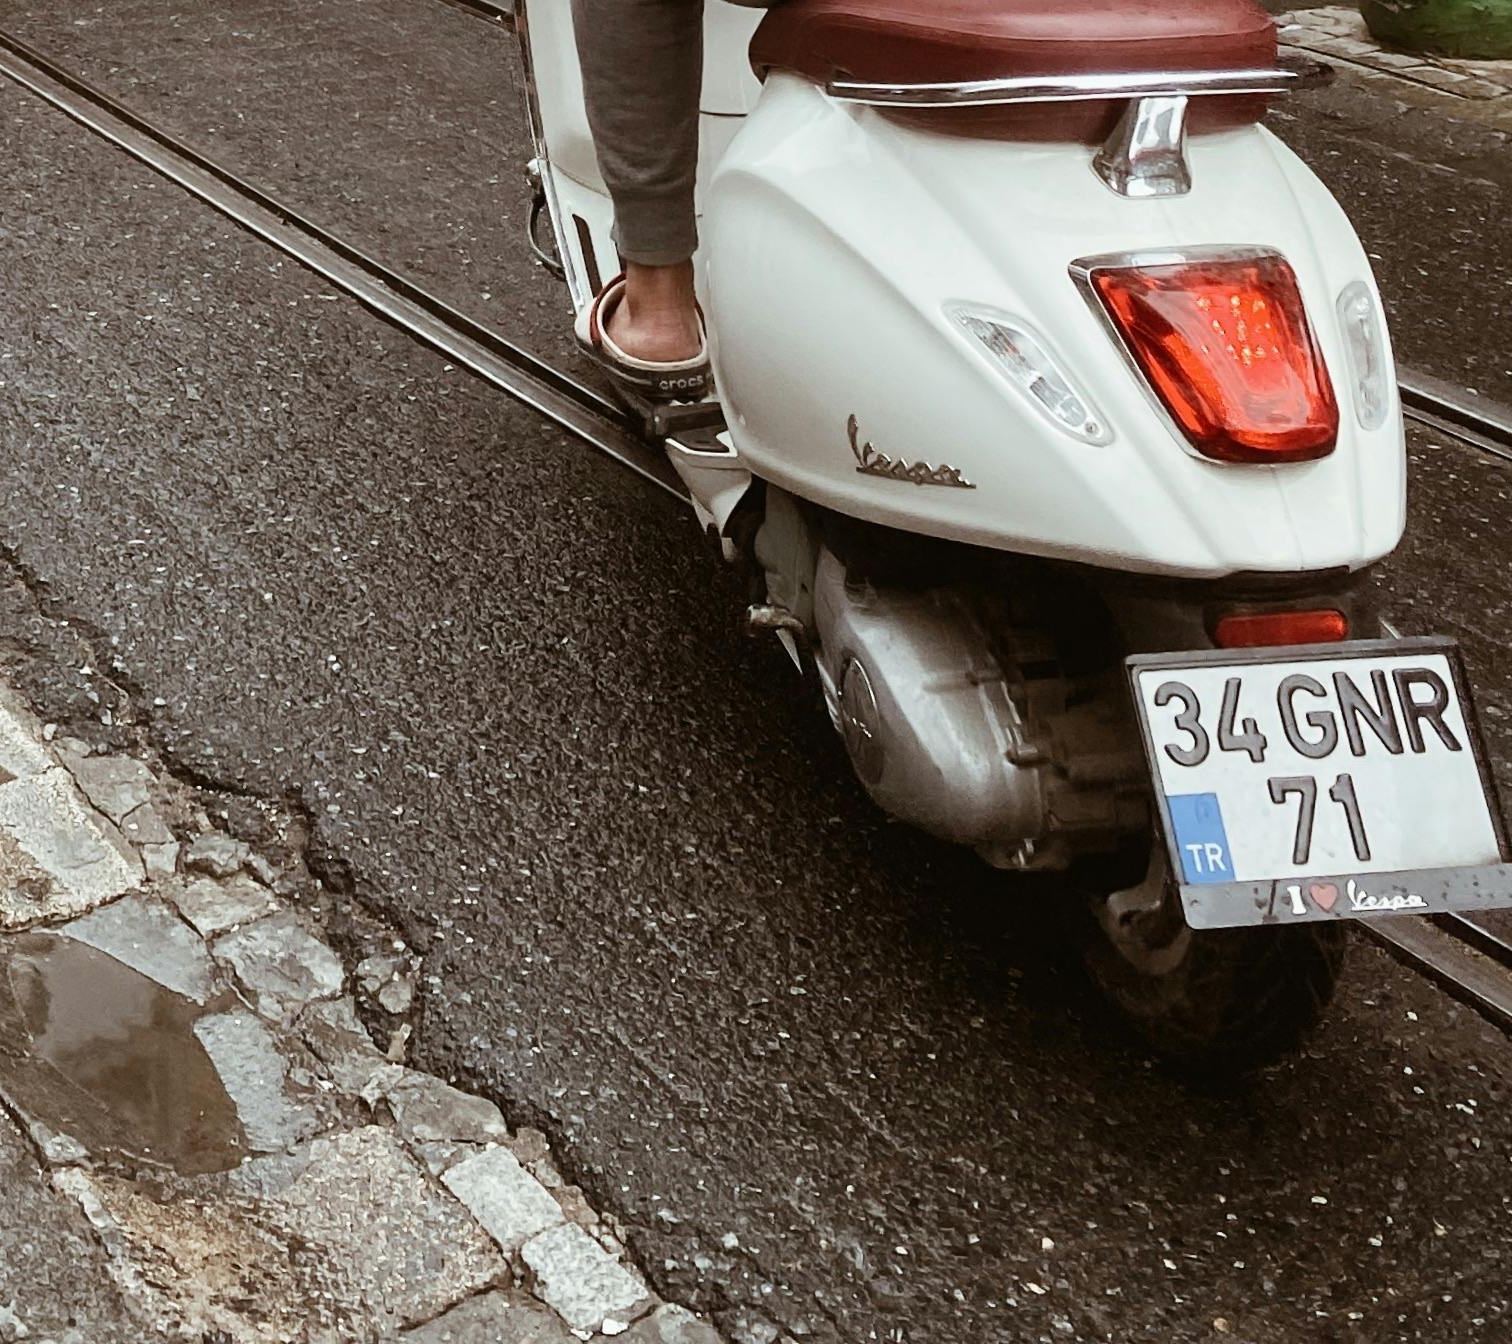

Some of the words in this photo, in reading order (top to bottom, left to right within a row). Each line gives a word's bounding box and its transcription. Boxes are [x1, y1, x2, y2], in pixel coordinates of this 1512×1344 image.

[847, 413, 977, 489] Vespa
[1154, 676, 1268, 767] 34
[1276, 667, 1463, 760] GNR
[1267, 772, 1372, 866] 71
[1185, 842, 1228, 873] TR
[1287, 884, 1307, 915] I
[1346, 878, 1429, 912] Vespa
